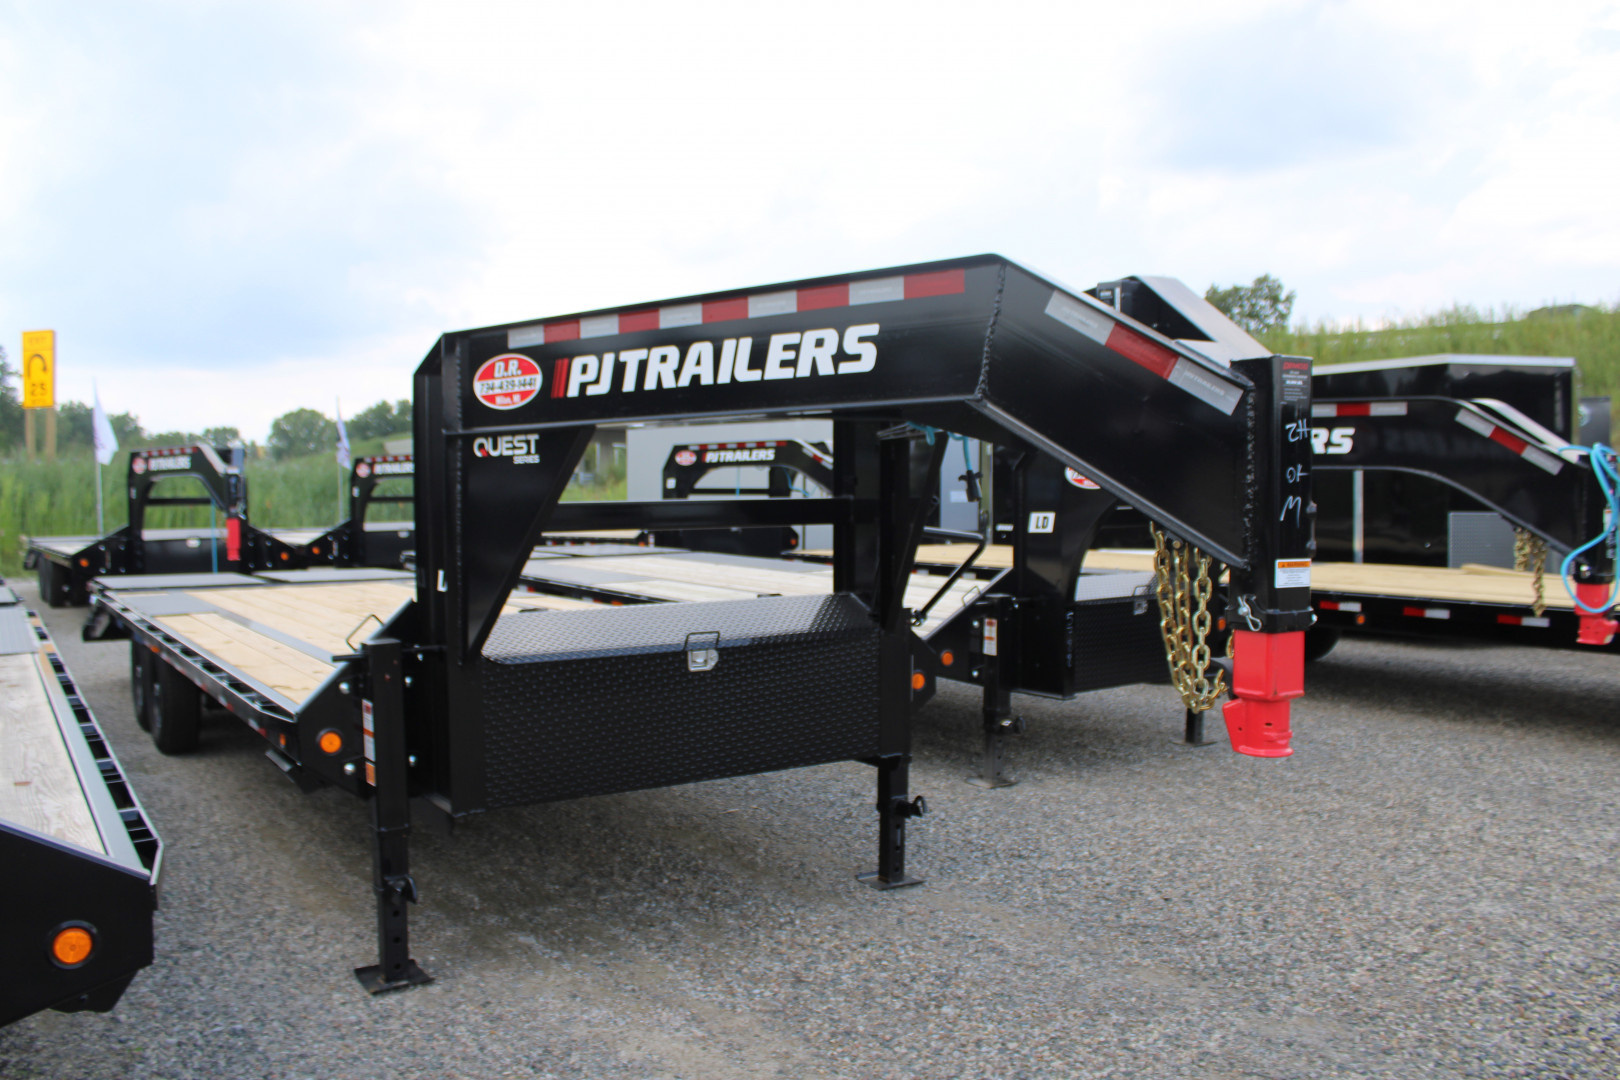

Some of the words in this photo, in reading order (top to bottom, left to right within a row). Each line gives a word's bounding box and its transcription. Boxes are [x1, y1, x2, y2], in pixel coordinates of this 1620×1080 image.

[494, 359, 522, 378] D.R.
[473, 434, 539, 457] QUEST
[1035, 516, 1050, 530] LD
